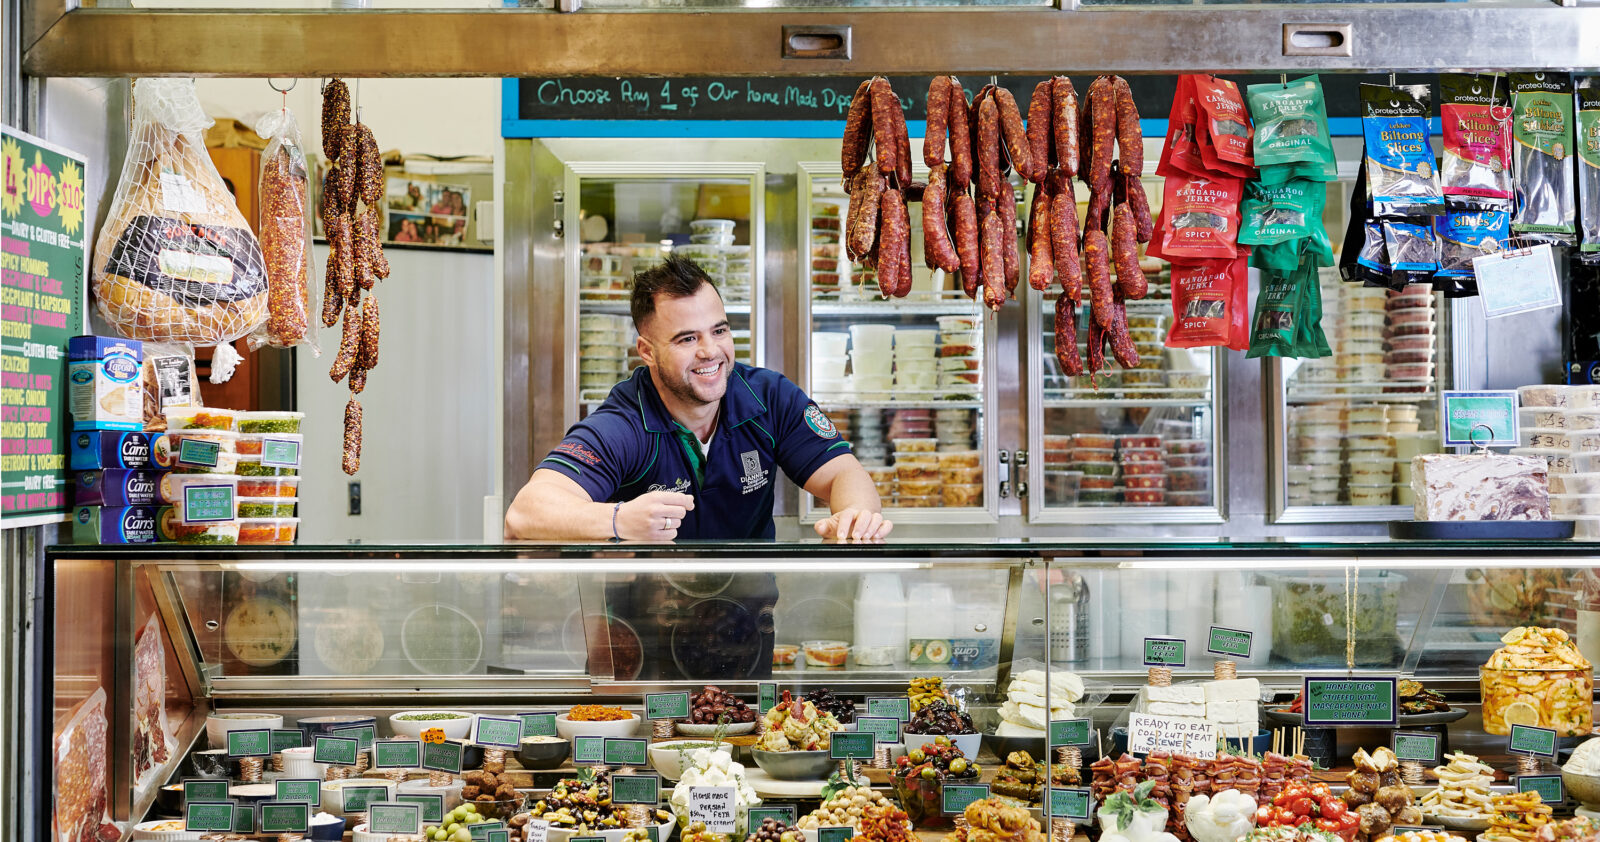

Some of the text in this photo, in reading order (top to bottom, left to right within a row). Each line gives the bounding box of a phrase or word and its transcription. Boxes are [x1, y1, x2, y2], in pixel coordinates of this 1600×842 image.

[1517, 81, 1561, 90] protea foods
[537, 79, 611, 105] Choose
[621, 79, 650, 109] Any
[660, 80, 671, 103] 4
[682, 86, 699, 107] of
[707, 81, 739, 101] Our
[747, 81, 779, 105] home
[785, 86, 817, 108] Made
[1455, 95, 1478, 103] protea
[1206, 95, 1242, 110] KANGAROO
[1216, 103, 1238, 113] JERKY
[1262, 99, 1314, 112] KANGAROO
[1273, 105, 1304, 115] JERKY
[1525, 108, 1562, 122] Biltong
[1458, 119, 1500, 136] Biltong
[1269, 138, 1312, 148] ORIGINAL
[1381, 131, 1425, 142] Biltong
[1463, 132, 1496, 145] Slices
[1230, 138, 1247, 149] SPICY
[1387, 142, 1422, 152] Slices
[6, 155, 17, 205] 4
[62, 181, 80, 210] $10
[1176, 188, 1228, 199] KANGAROO
[12, 220, 70, 249] DAIRY & GLUTEN FREE
[1254, 227, 1297, 236] ORIGINAL
[1180, 272, 1225, 285] KANGAROO
[1186, 280, 1214, 291] JERKY
[35, 293, 40, 310] &
[41, 295, 71, 314] CAPSICUM
[1184, 321, 1207, 329] SPICY
[24, 341, 58, 360] GLUTEN FREE
[26, 389, 46, 406] ONION
[27, 422, 47, 438] TROUT
[122, 441, 148, 456] Carr's
[31, 454, 36, 471] &
[25, 474, 55, 490] DAIRY FREE
[128, 478, 154, 493] Carr's
[125, 515, 154, 529] Carr's
[1325, 683, 1354, 691] HONEY
[1356, 683, 1375, 691] FIGS
[1367, 702, 1387, 710] NUTS
[1135, 718, 1213, 732] READY TO EAT
[1146, 737, 1192, 749] SKEWER
[1186, 732, 1213, 741] MEAT
